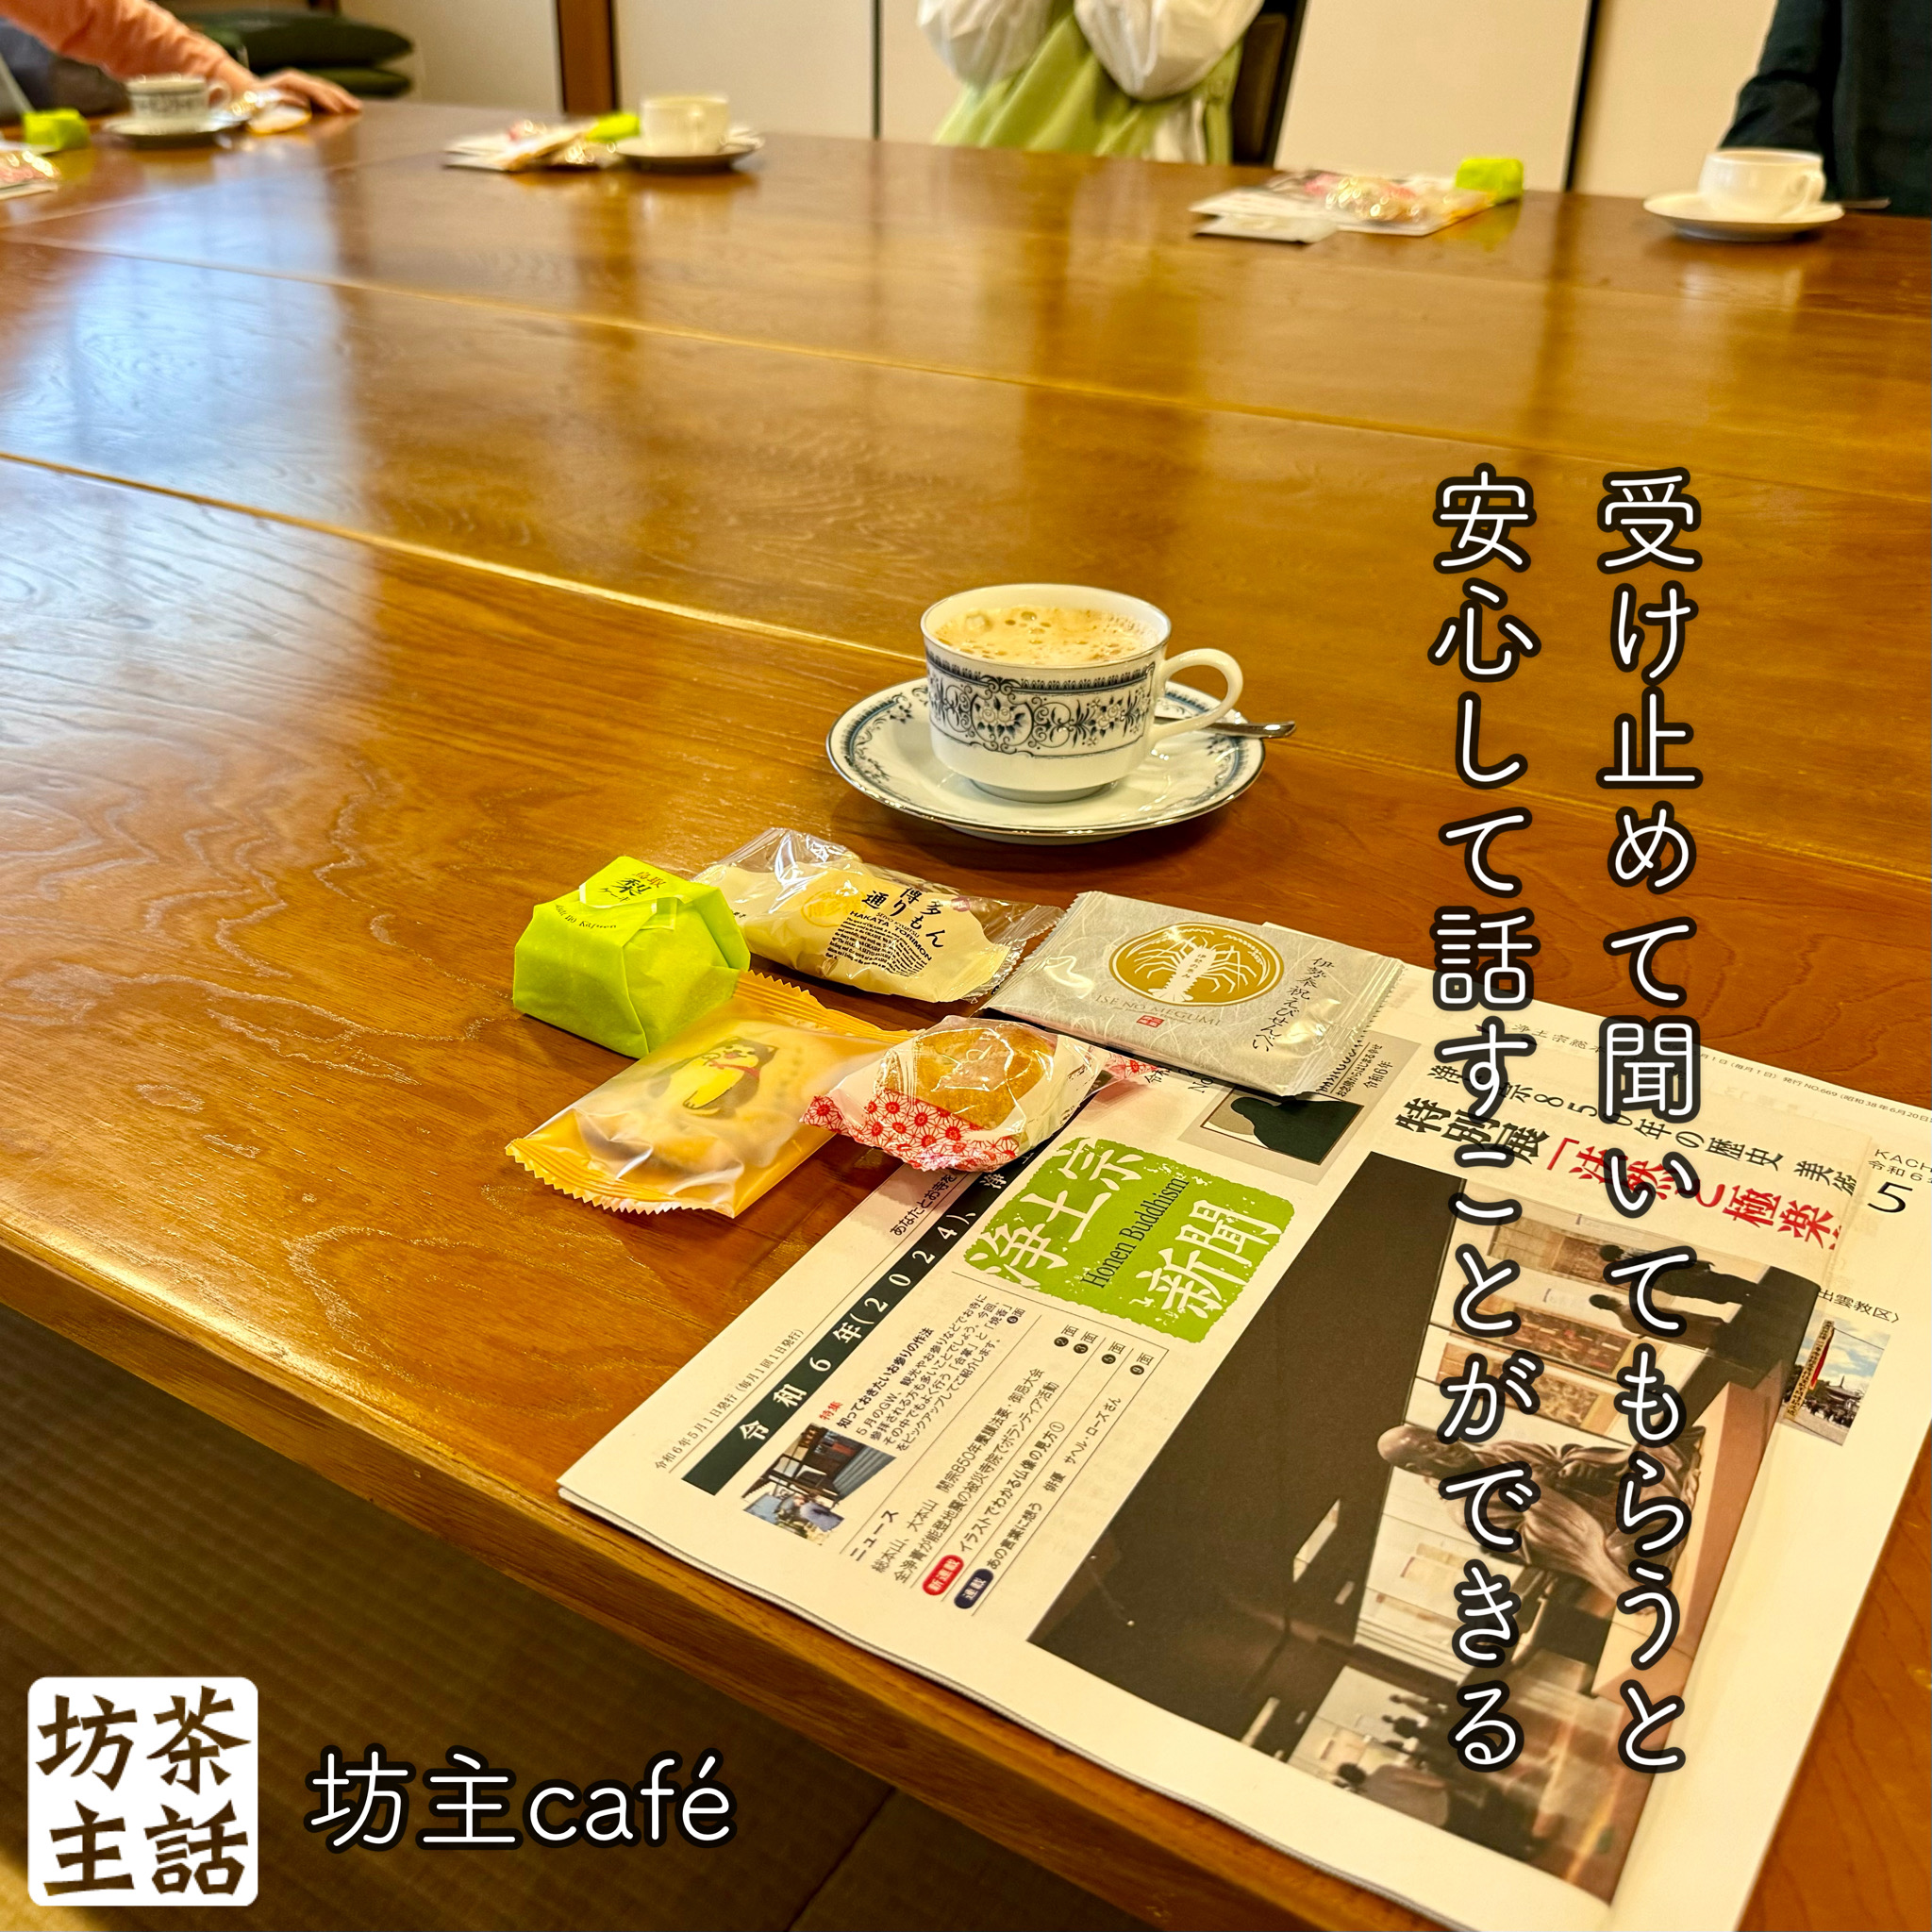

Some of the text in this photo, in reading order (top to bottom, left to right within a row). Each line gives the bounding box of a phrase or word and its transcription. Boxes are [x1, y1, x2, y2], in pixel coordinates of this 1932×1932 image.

[611, 878, 652, 896] 梨
[900, 888, 941, 915] 博多
[850, 910, 889, 927] HAKATA
[895, 926, 932, 960] TORIMON
[862, 891, 945, 947] 通りもん
[1095, 994, 1118, 1005] ISE
[1124, 1001, 1146, 1010] NO
[1151, 1006, 1222, 1026] MEGUMI
[1363, 1060, 1393, 1089] 令和6年
[969, 1137, 1144, 1288] 浄土宗
[1867, 1181, 1913, 1213] 5
[1081, 1176, 1190, 1289] Honen Buddhism
[1135, 1199, 1283, 1319] 新聞
[836, 1326, 934, 1429] 知っておきたいお参りの作法
[819, 1401, 844, 1421] 特集
[850, 1509, 899, 1562] ニュース
[964, 1575, 989, 1602] 連載
[986, 1502, 1042, 1570] あの言葉に想う
[928, 1558, 961, 1593] 新連載
